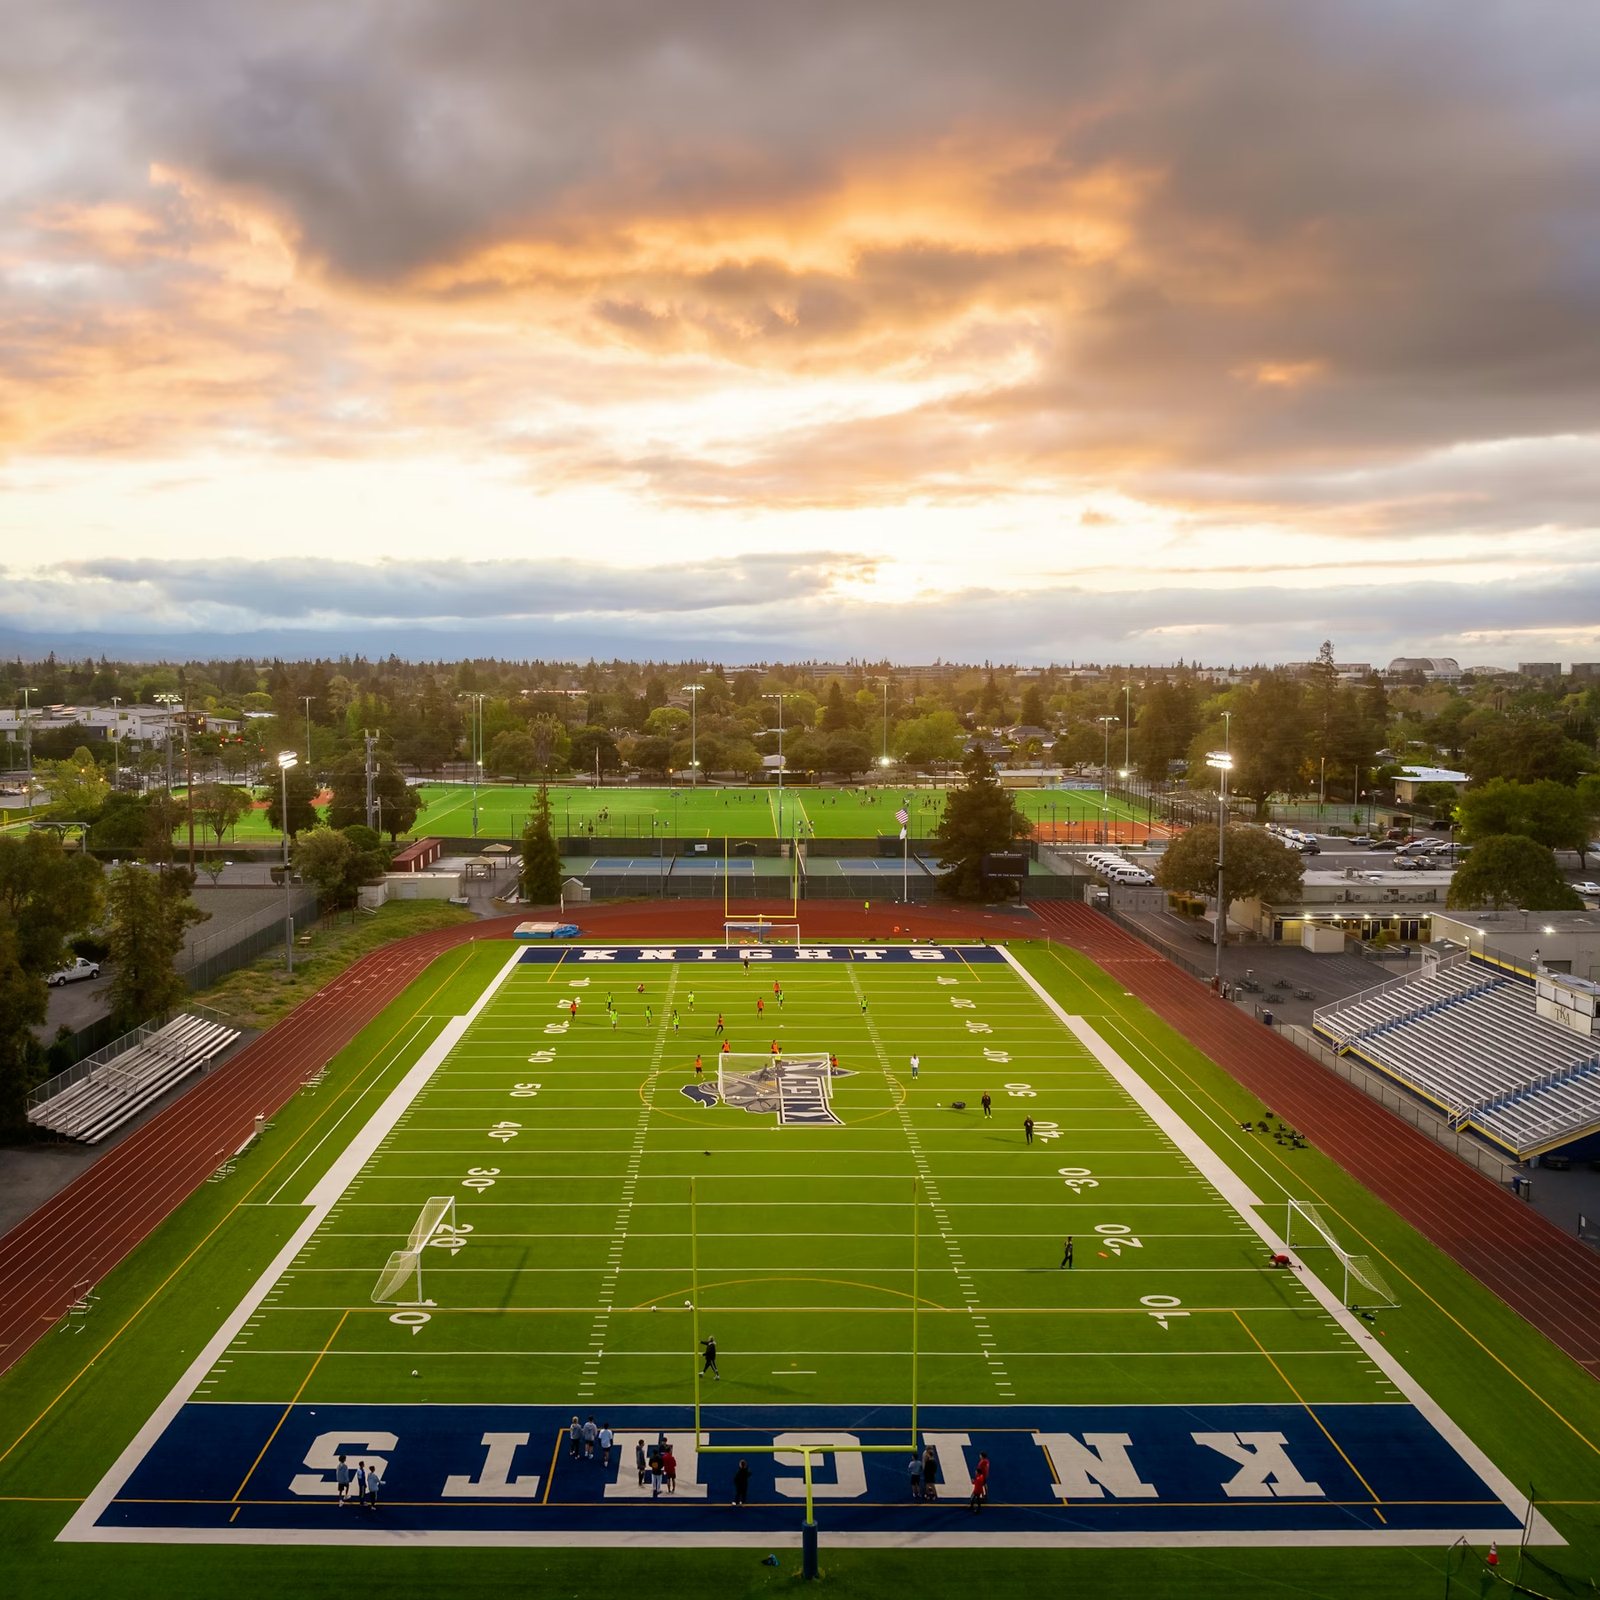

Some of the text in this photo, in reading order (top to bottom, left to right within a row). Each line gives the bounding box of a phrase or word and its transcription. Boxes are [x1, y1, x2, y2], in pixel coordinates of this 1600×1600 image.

[578, 949, 946, 960] KNIGHTS
[568, 979, 591, 987] 10
[557, 999, 581, 1009] 20
[950, 999, 976, 1008] 20
[1555, 1006, 1571, 1026] TKA
[543, 1023, 570, 1034] 30
[966, 1023, 993, 1034] 30
[527, 1050, 557, 1063] 40
[983, 1050, 1013, 1063] 40
[509, 1083, 542, 1097] 50
[1004, 1083, 1037, 1097] 50
[487, 1121, 523, 1138] 40
[1032, 1121, 1065, 1138] 40
[461, 1167, 501, 1187] 30
[1057, 1167, 1100, 1187] 30
[429, 1223, 474, 1248] 20
[1094, 1223, 1144, 1248] 20
[388, 1298, 438, 1325] 10
[1139, 1294, 1191, 1317] 10
[289, 1431, 1325, 1498] KNIGHTS
